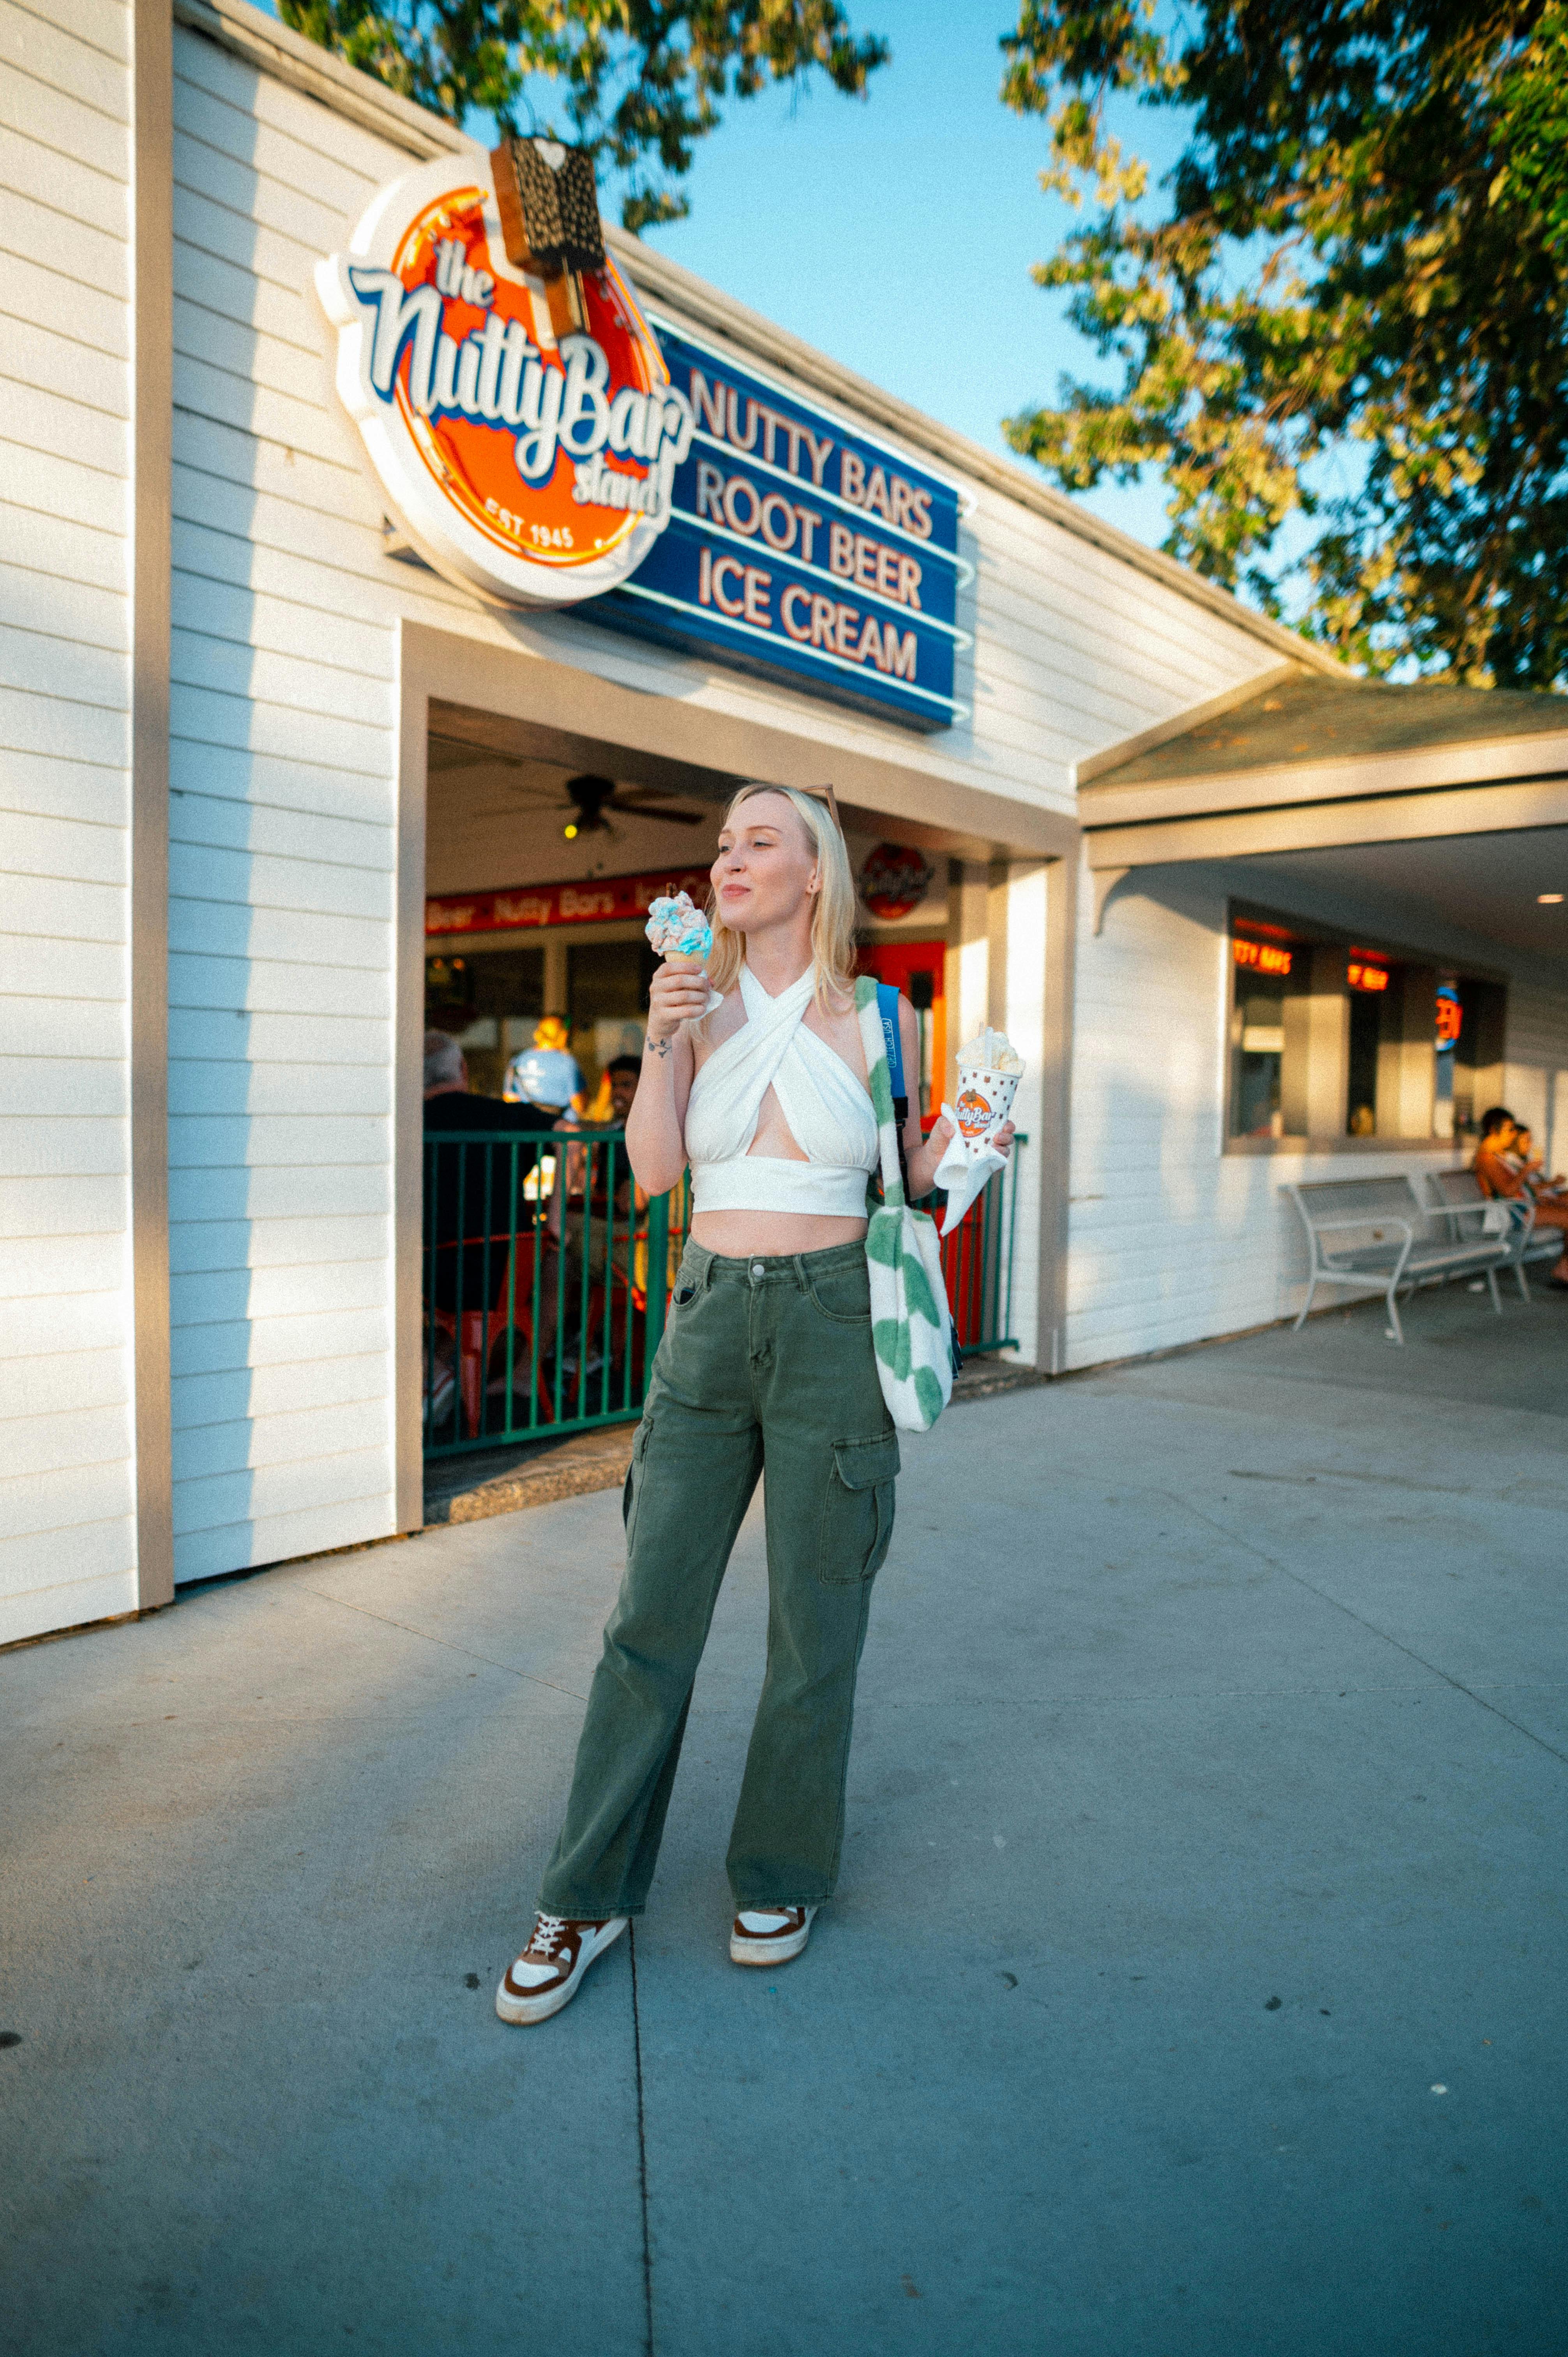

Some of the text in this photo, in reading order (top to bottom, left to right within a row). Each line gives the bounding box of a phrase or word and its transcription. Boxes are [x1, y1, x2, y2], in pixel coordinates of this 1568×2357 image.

[433, 237, 494, 308] the
[690, 368, 932, 539] NUTTY BARS
[485, 497, 574, 548] EST 1945
[696, 459, 922, 610] ROOT BEER
[699, 547, 917, 681] ICE CREAM
[883, 1021, 892, 1034] USA
